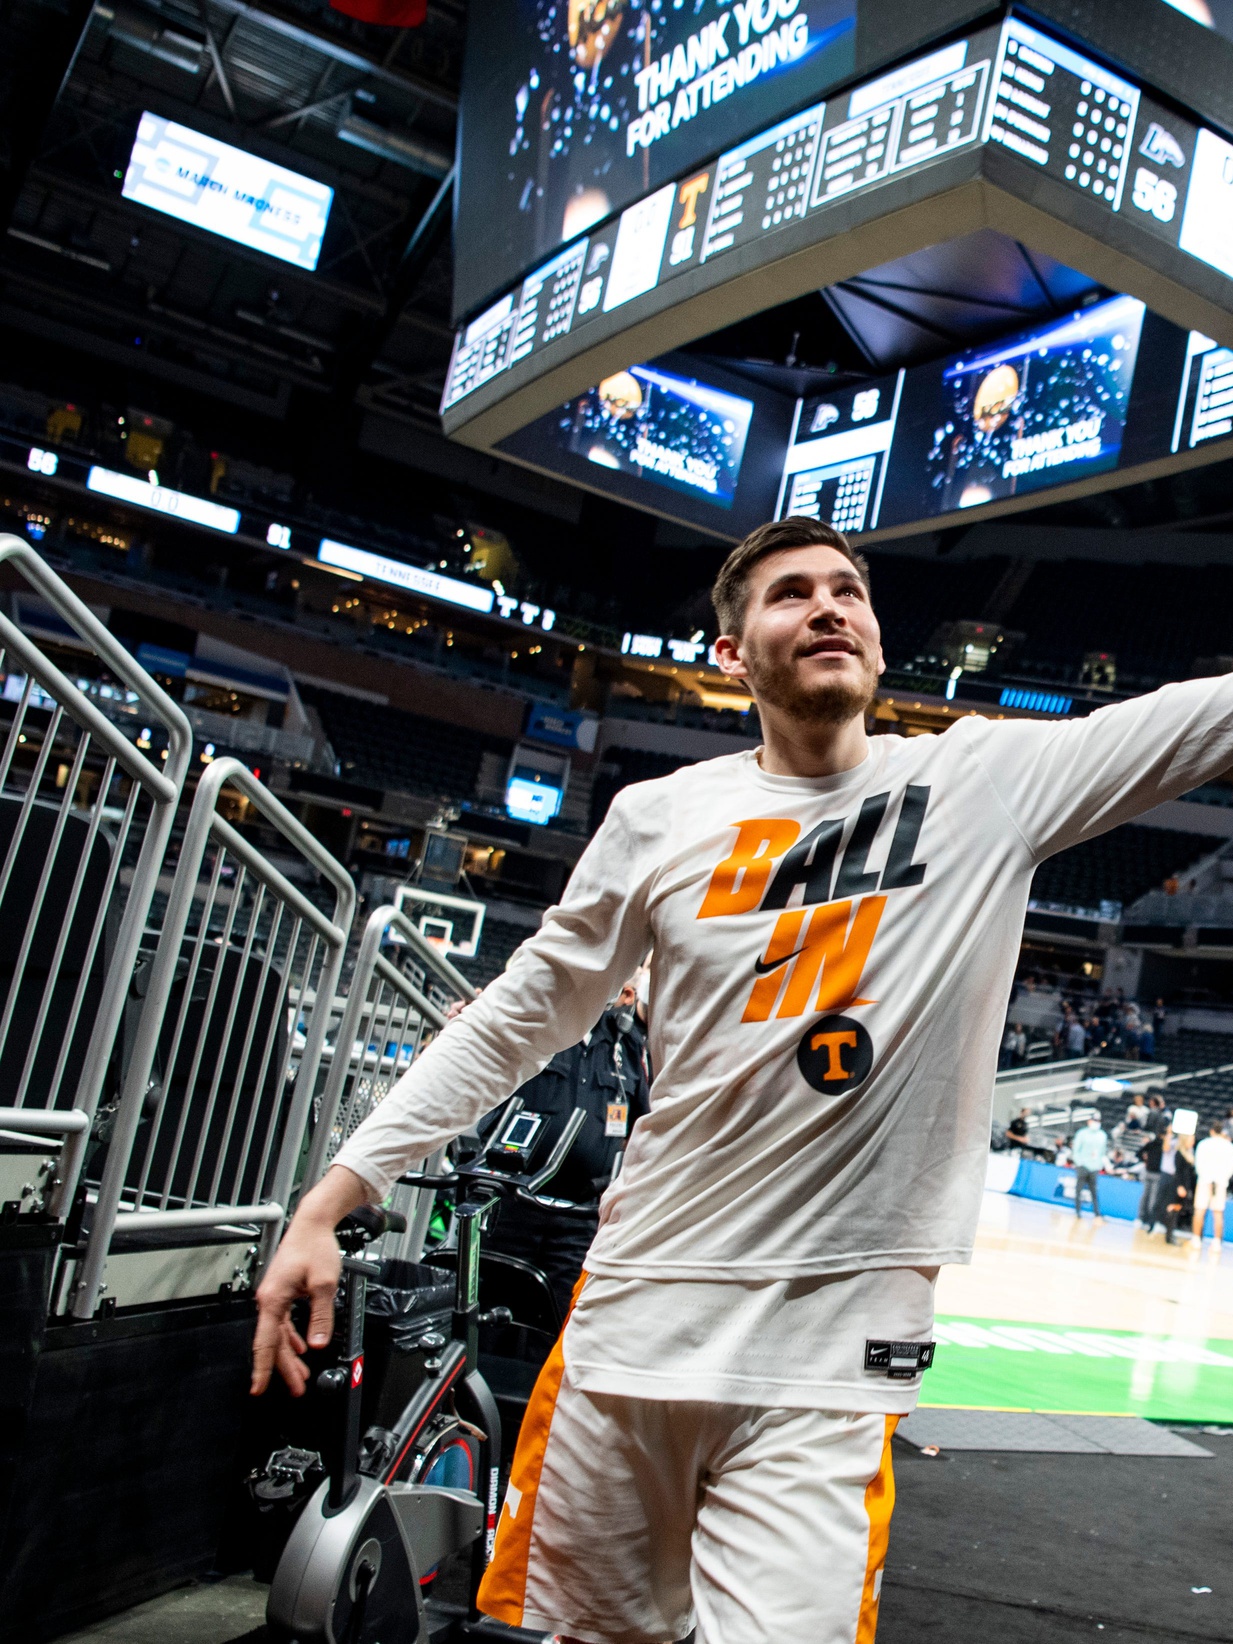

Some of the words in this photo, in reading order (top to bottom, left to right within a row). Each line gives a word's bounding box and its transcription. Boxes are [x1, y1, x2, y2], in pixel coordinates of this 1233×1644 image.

[626, 101, 671, 157] FOR
[671, 13, 809, 129] ATTENDING
[634, 12, 730, 112] THANK
[176, 166, 228, 195] MARCH
[233, 189, 301, 226] MADNESS
[679, 172, 709, 229] T
[636, 436, 686, 468] THANK
[686, 456, 717, 480] YOU
[1010, 427, 1066, 460] THANK
[1065, 416, 1101, 445] YOU
[376, 562, 441, 592] TENNESSEE
[696, 784, 932, 920] BALL
[740, 895, 888, 1023] IN
[810, 1030, 857, 1081] T
